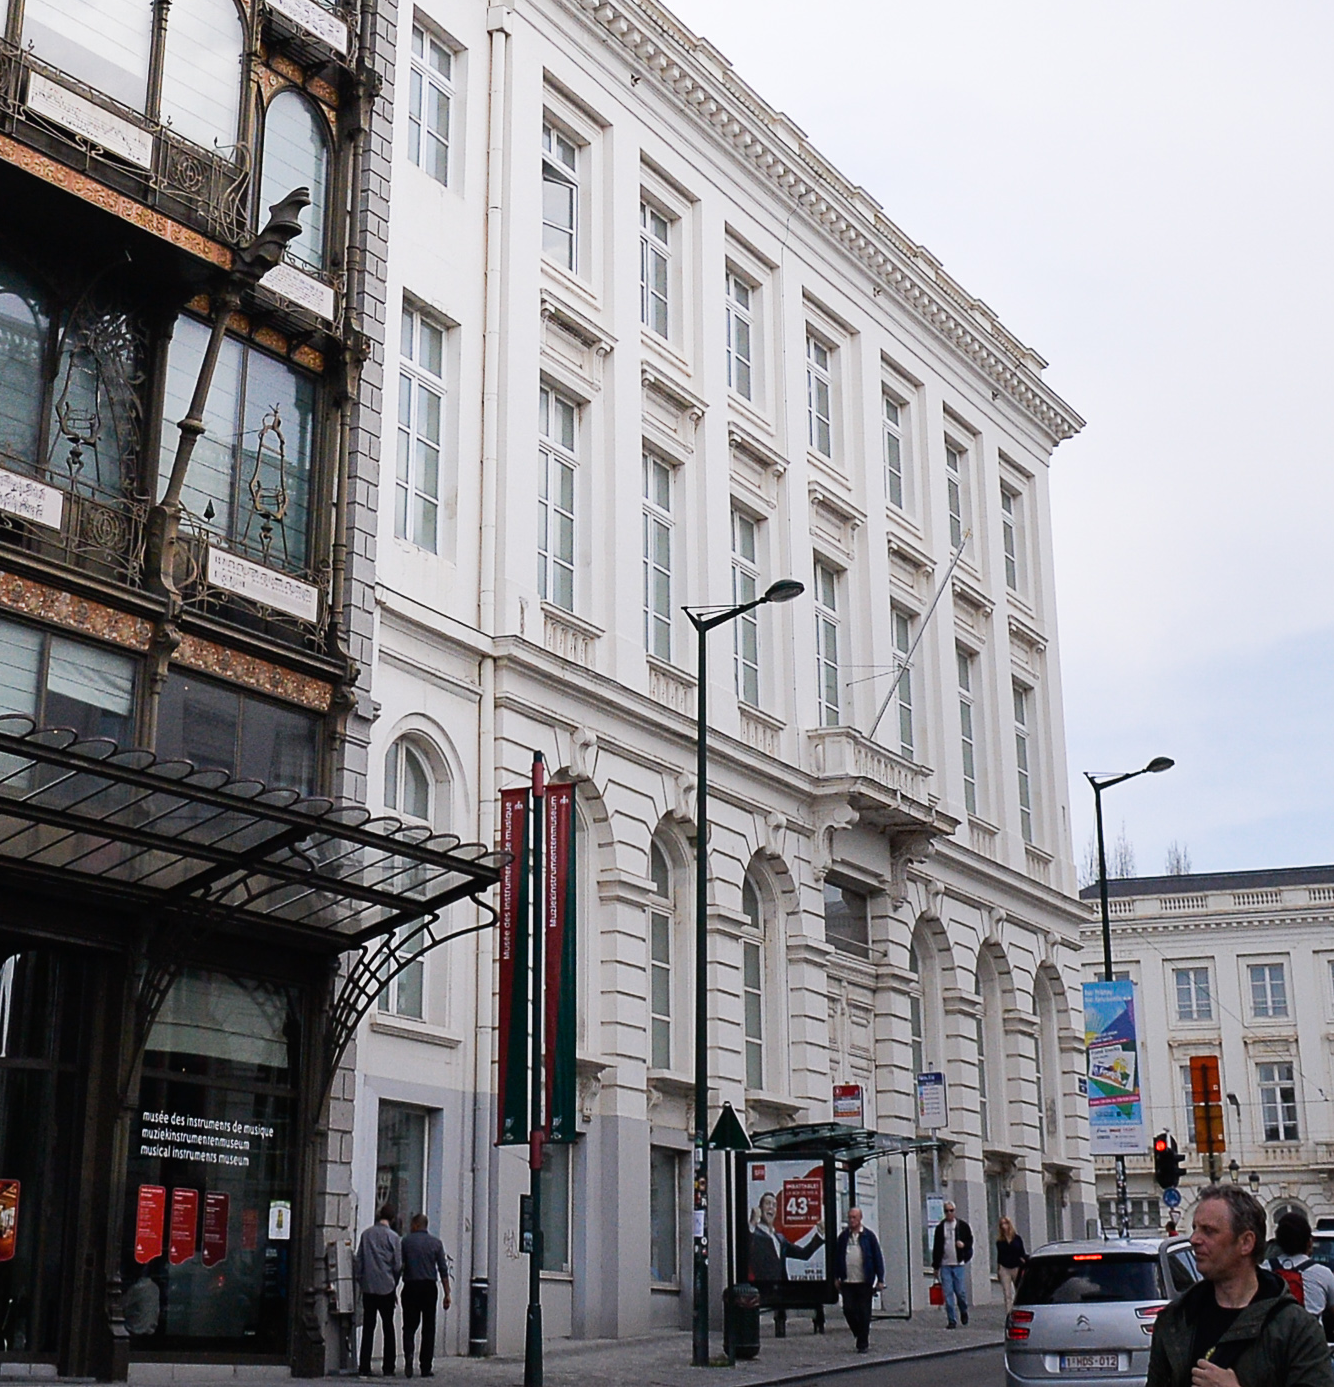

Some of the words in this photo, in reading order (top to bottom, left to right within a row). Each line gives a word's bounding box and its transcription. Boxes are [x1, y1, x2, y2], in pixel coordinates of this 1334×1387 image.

[505, 801, 513, 840] musique
[549, 795, 558, 928] Muziekinstrumentenmuseum
[504, 912, 512, 929] des
[503, 930, 511, 960] Musée
[142, 1110, 169, 1124] musée
[170, 1112, 185, 1126] des
[186, 1114, 231, 1132] instruments
[232, 1120, 242, 1133] de
[243, 1123, 274, 1140] musique
[141, 1127, 250, 1150] muziekinstrumentenmuseum
[140, 1144, 171, 1158] musical
[172, 1146, 217, 1163] instruments
[218, 1153, 250, 1166] museum
[786, 1197, 808, 1215] 43
